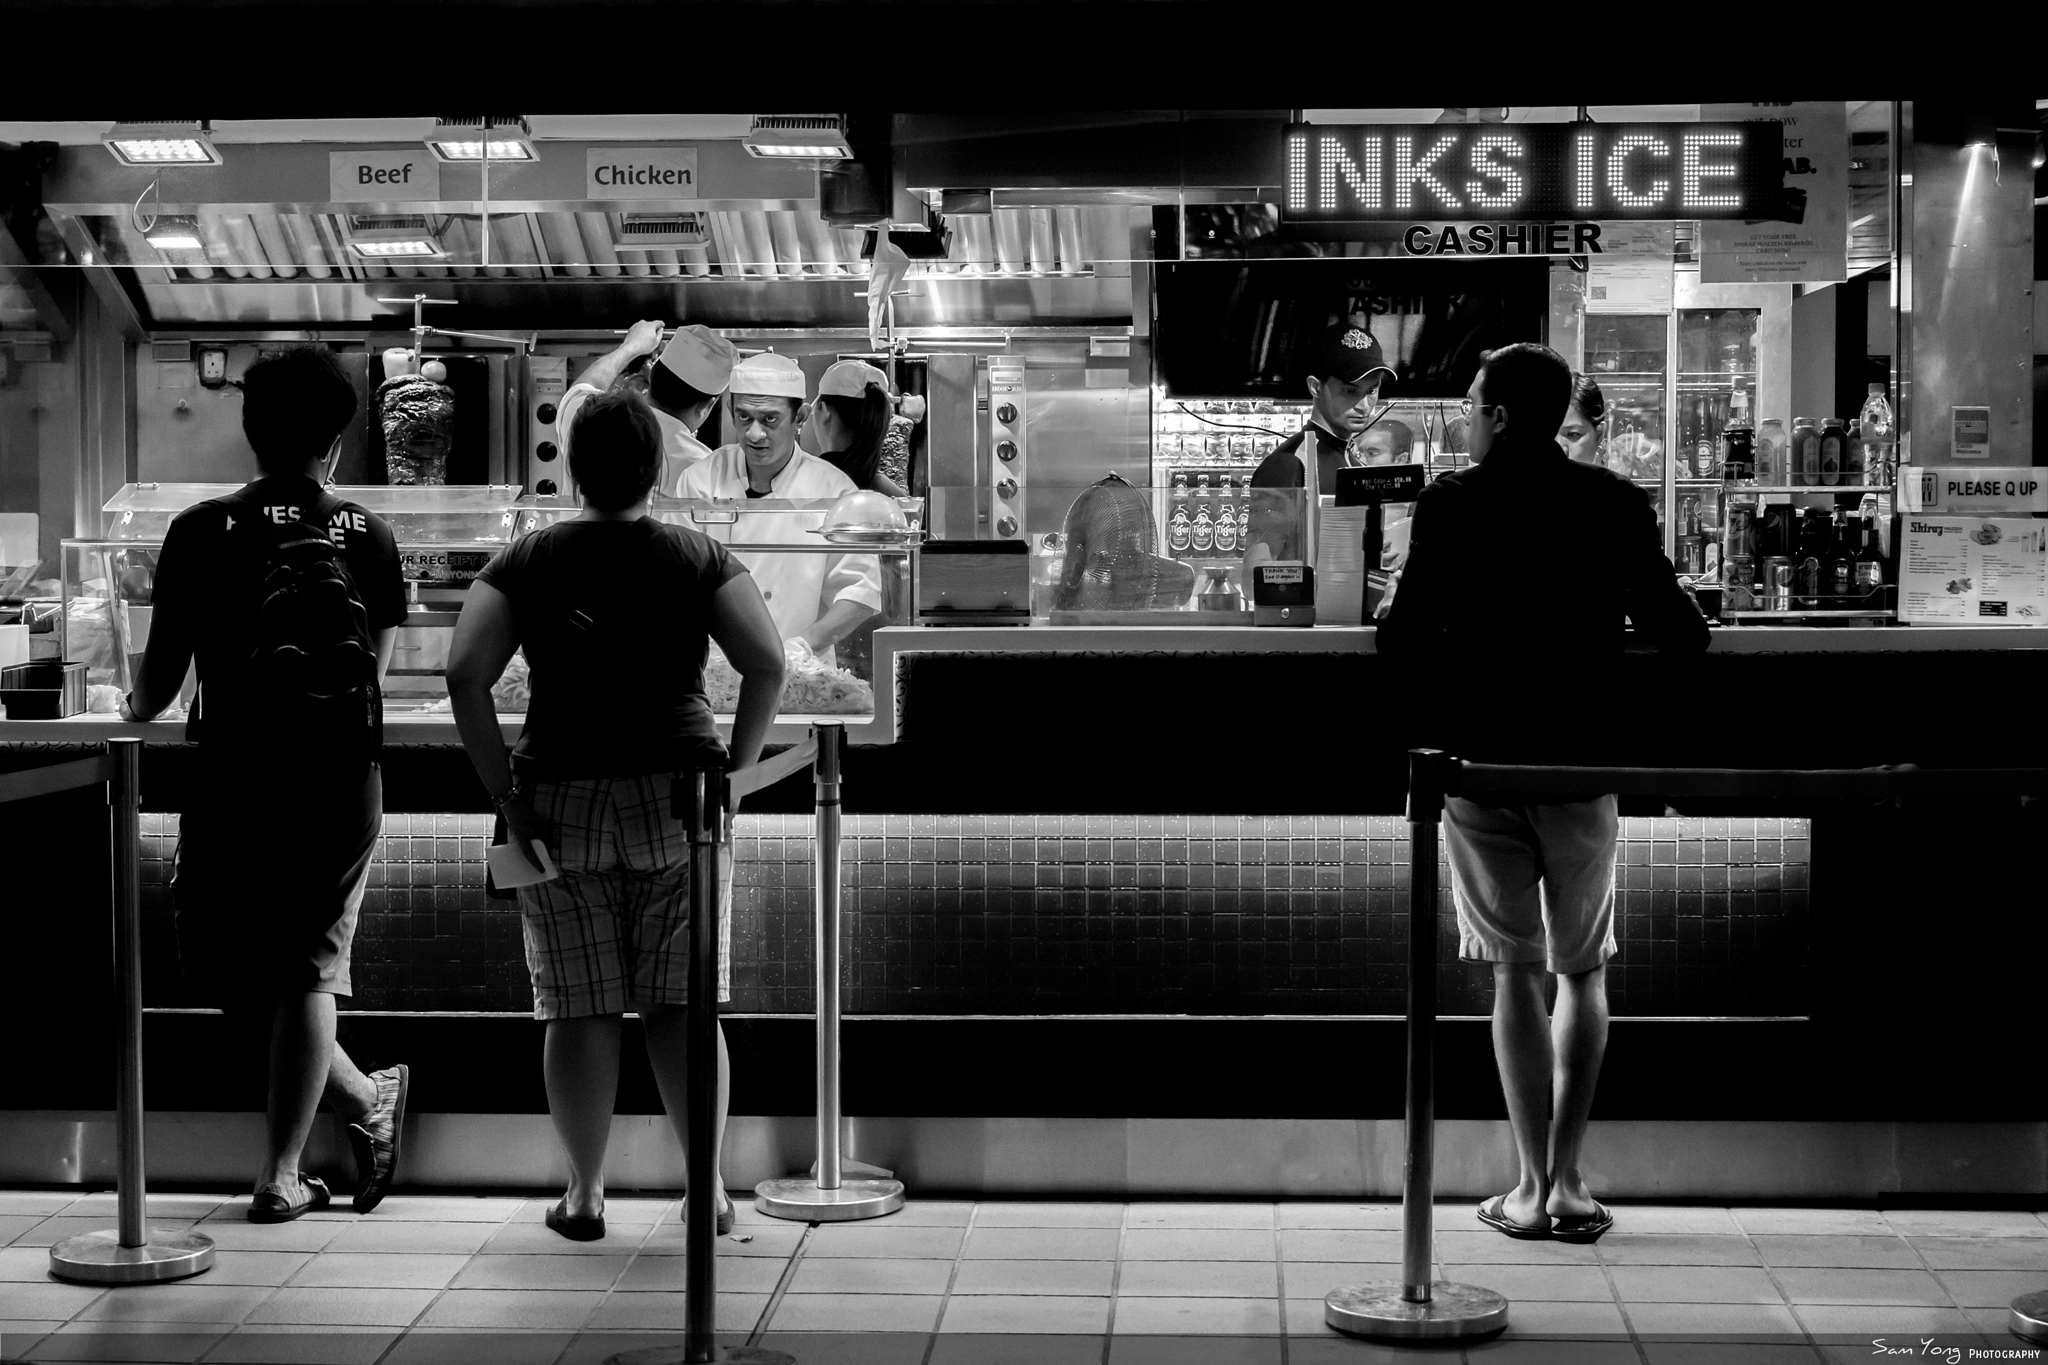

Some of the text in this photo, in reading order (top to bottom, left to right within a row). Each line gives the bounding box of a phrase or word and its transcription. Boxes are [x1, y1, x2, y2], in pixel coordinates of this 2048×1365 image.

[1783, 138, 1804, 148] ter
[358, 163, 412, 184] Beef
[594, 163, 692, 186] Chicken
[1289, 134, 1743, 209] INKS ICE
[1403, 224, 1603, 256] CASHIER
[1948, 481, 2038, 497] PLEASE Q UP
[1171, 524, 1190, 536] Tiger
[1193, 524, 1213, 536] Tiger
[1216, 524, 1236, 536] Tiger
[419, 555, 478, 565] RECEIPT
